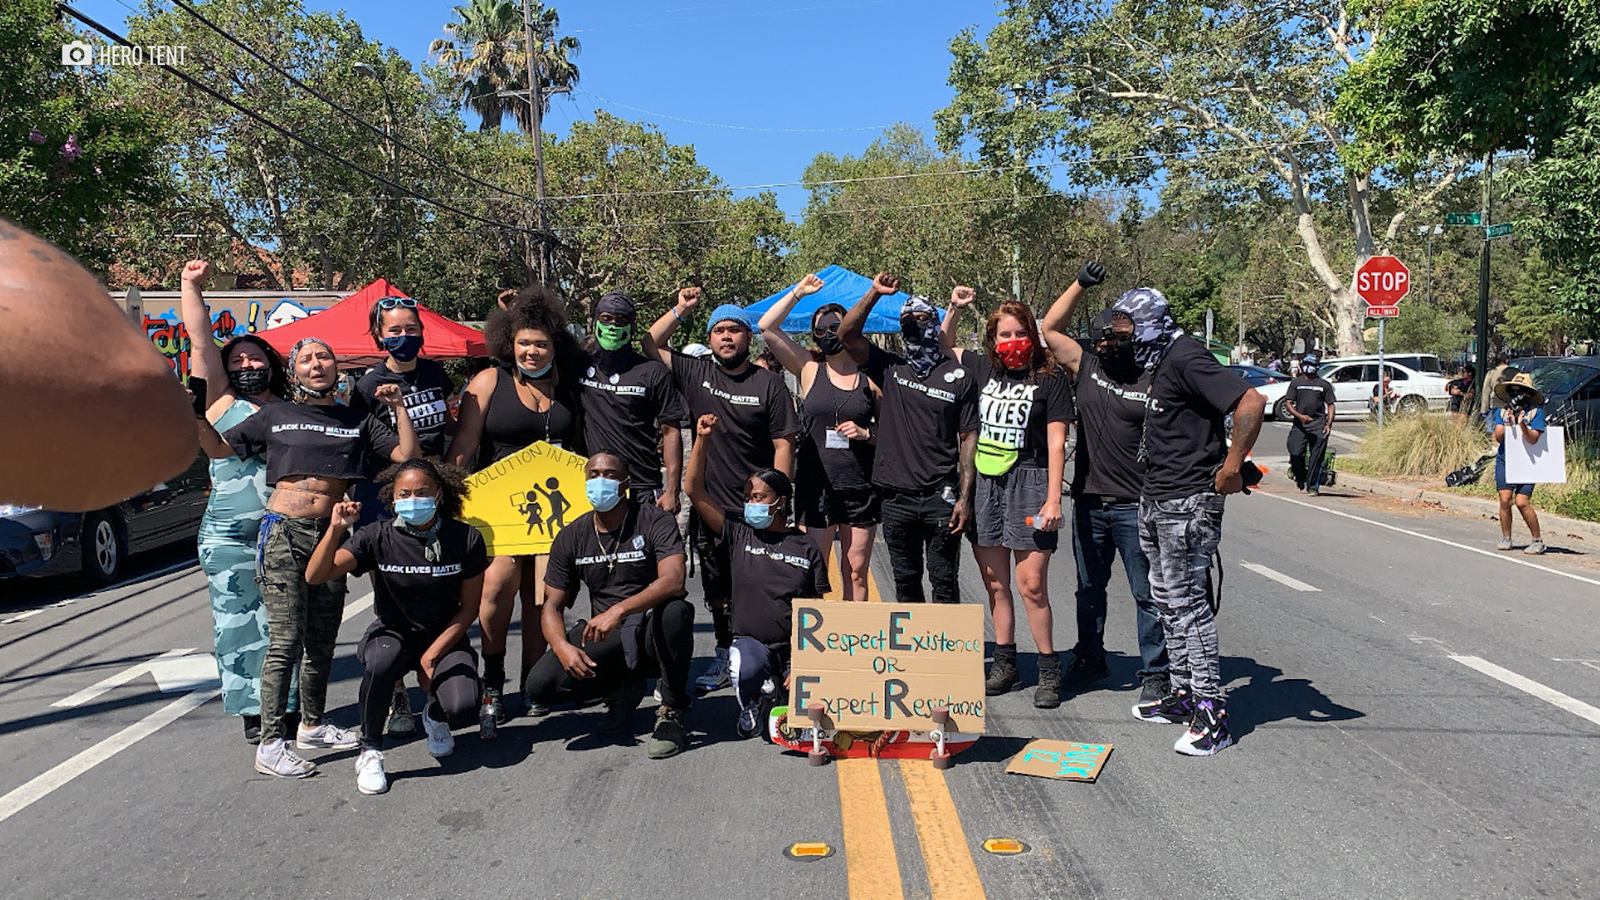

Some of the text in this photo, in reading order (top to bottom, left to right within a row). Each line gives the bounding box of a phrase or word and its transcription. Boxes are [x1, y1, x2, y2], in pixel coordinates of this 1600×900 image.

[1359, 271, 1407, 292] STOP
[1369, 308, 1397, 316] ALL WAY
[616, 385, 646, 394] MATTER
[981, 378, 1039, 402] BLACK
[730, 395, 760, 404] MATTER
[271, 423, 360, 437] BLACK LIVES MATTER
[546, 447, 563, 463] IN
[405, 565, 431, 574] LIVES
[797, 607, 982, 657] Respect Existence
[873, 656, 906, 675] OR
[795, 675, 880, 722] Expect
[1023, 748, 1062, 763] 12
[1056, 743, 1106, 777] FUCK
